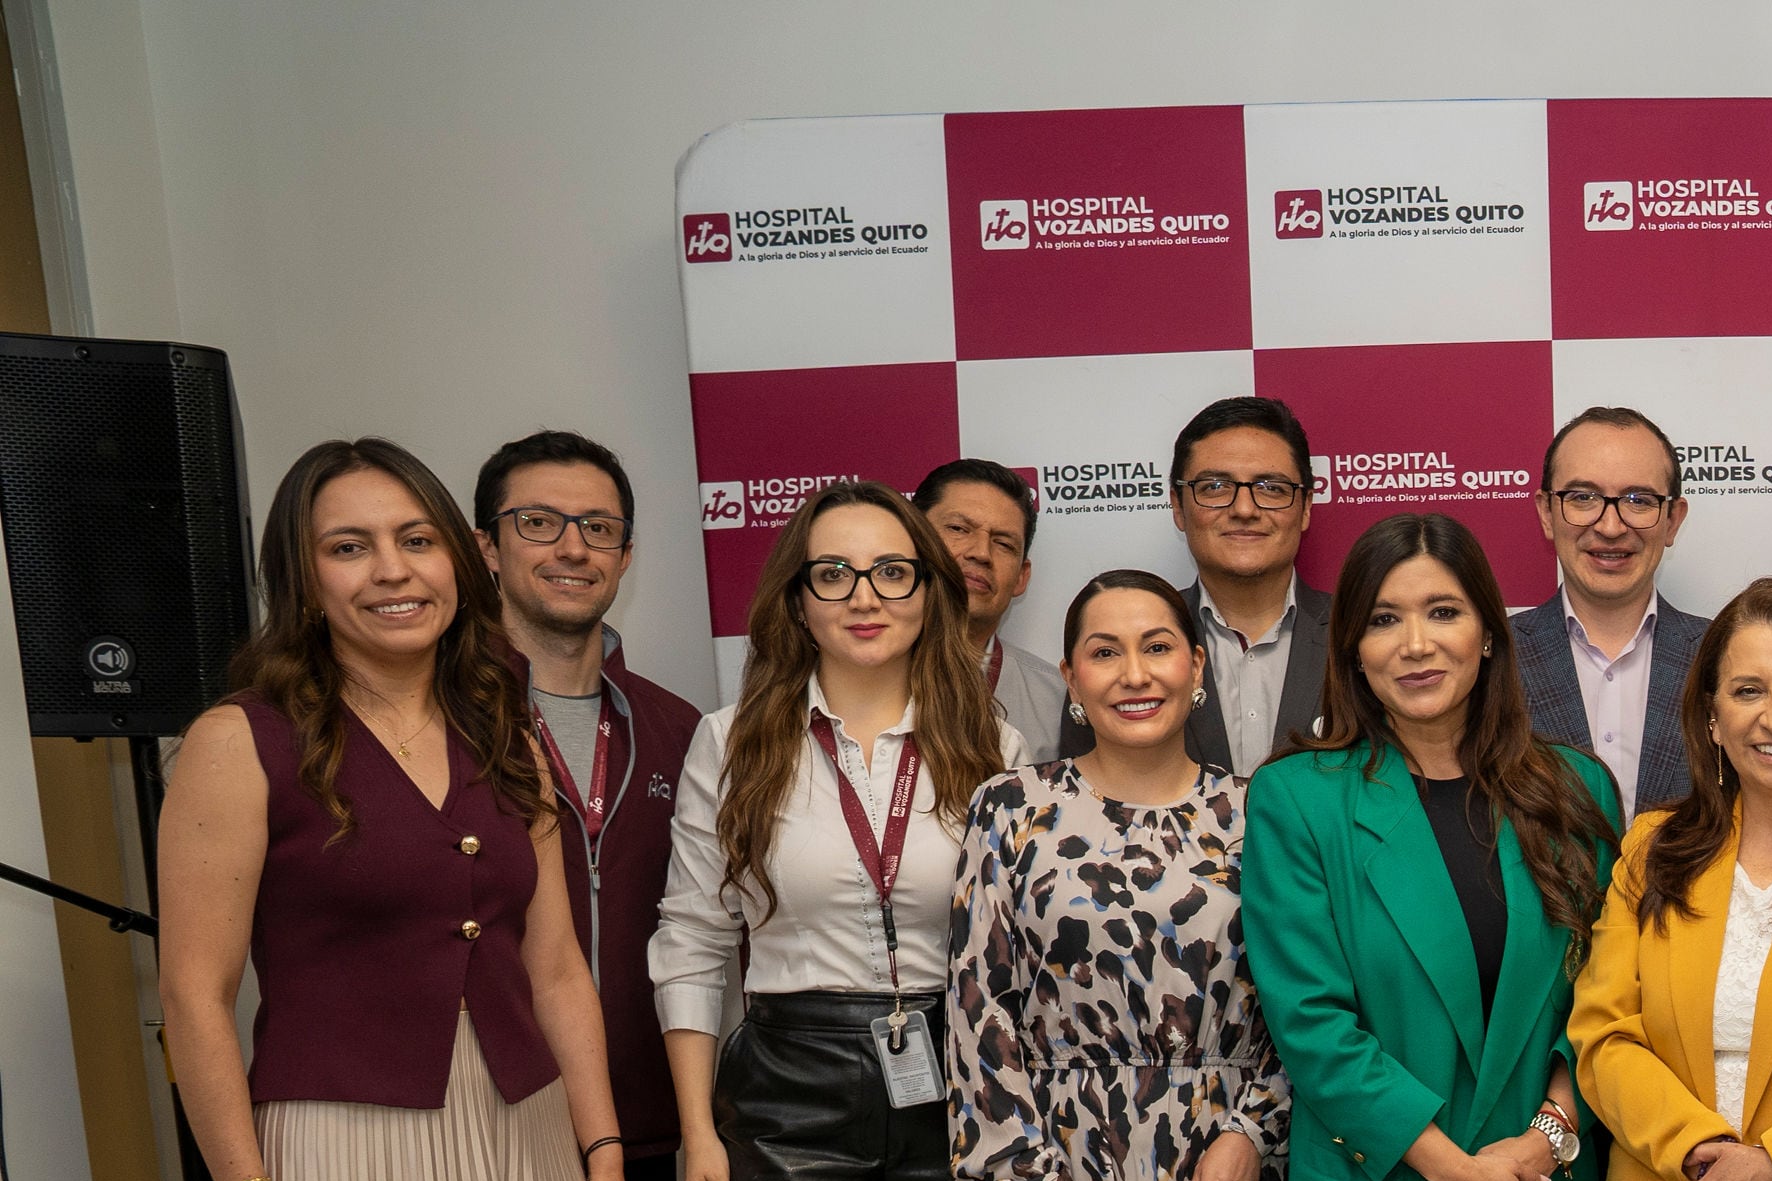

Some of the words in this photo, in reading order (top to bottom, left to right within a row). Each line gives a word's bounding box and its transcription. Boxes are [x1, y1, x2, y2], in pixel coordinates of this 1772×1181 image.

[1327, 185, 1448, 205] HOSPITAL
[1637, 179, 1758, 198] HOSPITAL
[1032, 196, 1153, 216] HOSPITAL
[1328, 206, 1449, 224] VOZANDES
[1455, 204, 1524, 224] QUITO
[1638, 199, 1760, 216] VOZANDES
[735, 206, 853, 228] HOSPITAL
[1033, 216, 1155, 235] VOZANDES
[1160, 214, 1229, 235] QUITO
[1658, 221, 1685, 231] gloria
[1686, 221, 1699, 229] de
[1701, 220, 1722, 229] Dios
[1723, 222, 1729, 230] y
[1731, 220, 1739, 228] al
[736, 226, 855, 248] VOZANDES
[860, 223, 927, 245] QUITO
[1348, 228, 1375, 239] gloria
[1391, 228, 1412, 236] Dios
[1413, 229, 1419, 237] y
[1432, 226, 1467, 235] servicio
[1469, 226, 1484, 234] del
[1486, 225, 1524, 233] Ecuador
[1054, 239, 1081, 250] gloria
[1082, 239, 1095, 248] de
[1096, 238, 1117, 247] Dios
[1118, 240, 1125, 248] y
[1126, 238, 1135, 246] al
[1137, 236, 1173, 246] servicio
[1174, 236, 1189, 244] del
[1191, 235, 1229, 244] Ecuador
[757, 251, 783, 262] gloria
[798, 250, 819, 258] Dios
[820, 251, 826, 259] y
[828, 249, 836, 257] al
[838, 247, 873, 256] servicio
[874, 246, 889, 254] del
[891, 245, 928, 254] Ecuador
[1335, 451, 1454, 472] HOSPITAL
[1675, 446, 1754, 463] SPITAL
[1043, 461, 1162, 482] HOSPITAL
[1336, 471, 1456, 490] VOZANDES
[1461, 470, 1529, 489] QUITO
[1682, 465, 1755, 481] ANDES
[1044, 481, 1164, 500] VOZANDES
[1356, 494, 1382, 504] gloria
[1398, 493, 1419, 501] Dios
[1428, 492, 1436, 500] al
[1438, 491, 1474, 500] servicio
[1475, 491, 1490, 499] del
[1492, 490, 1530, 499] Ecuador
